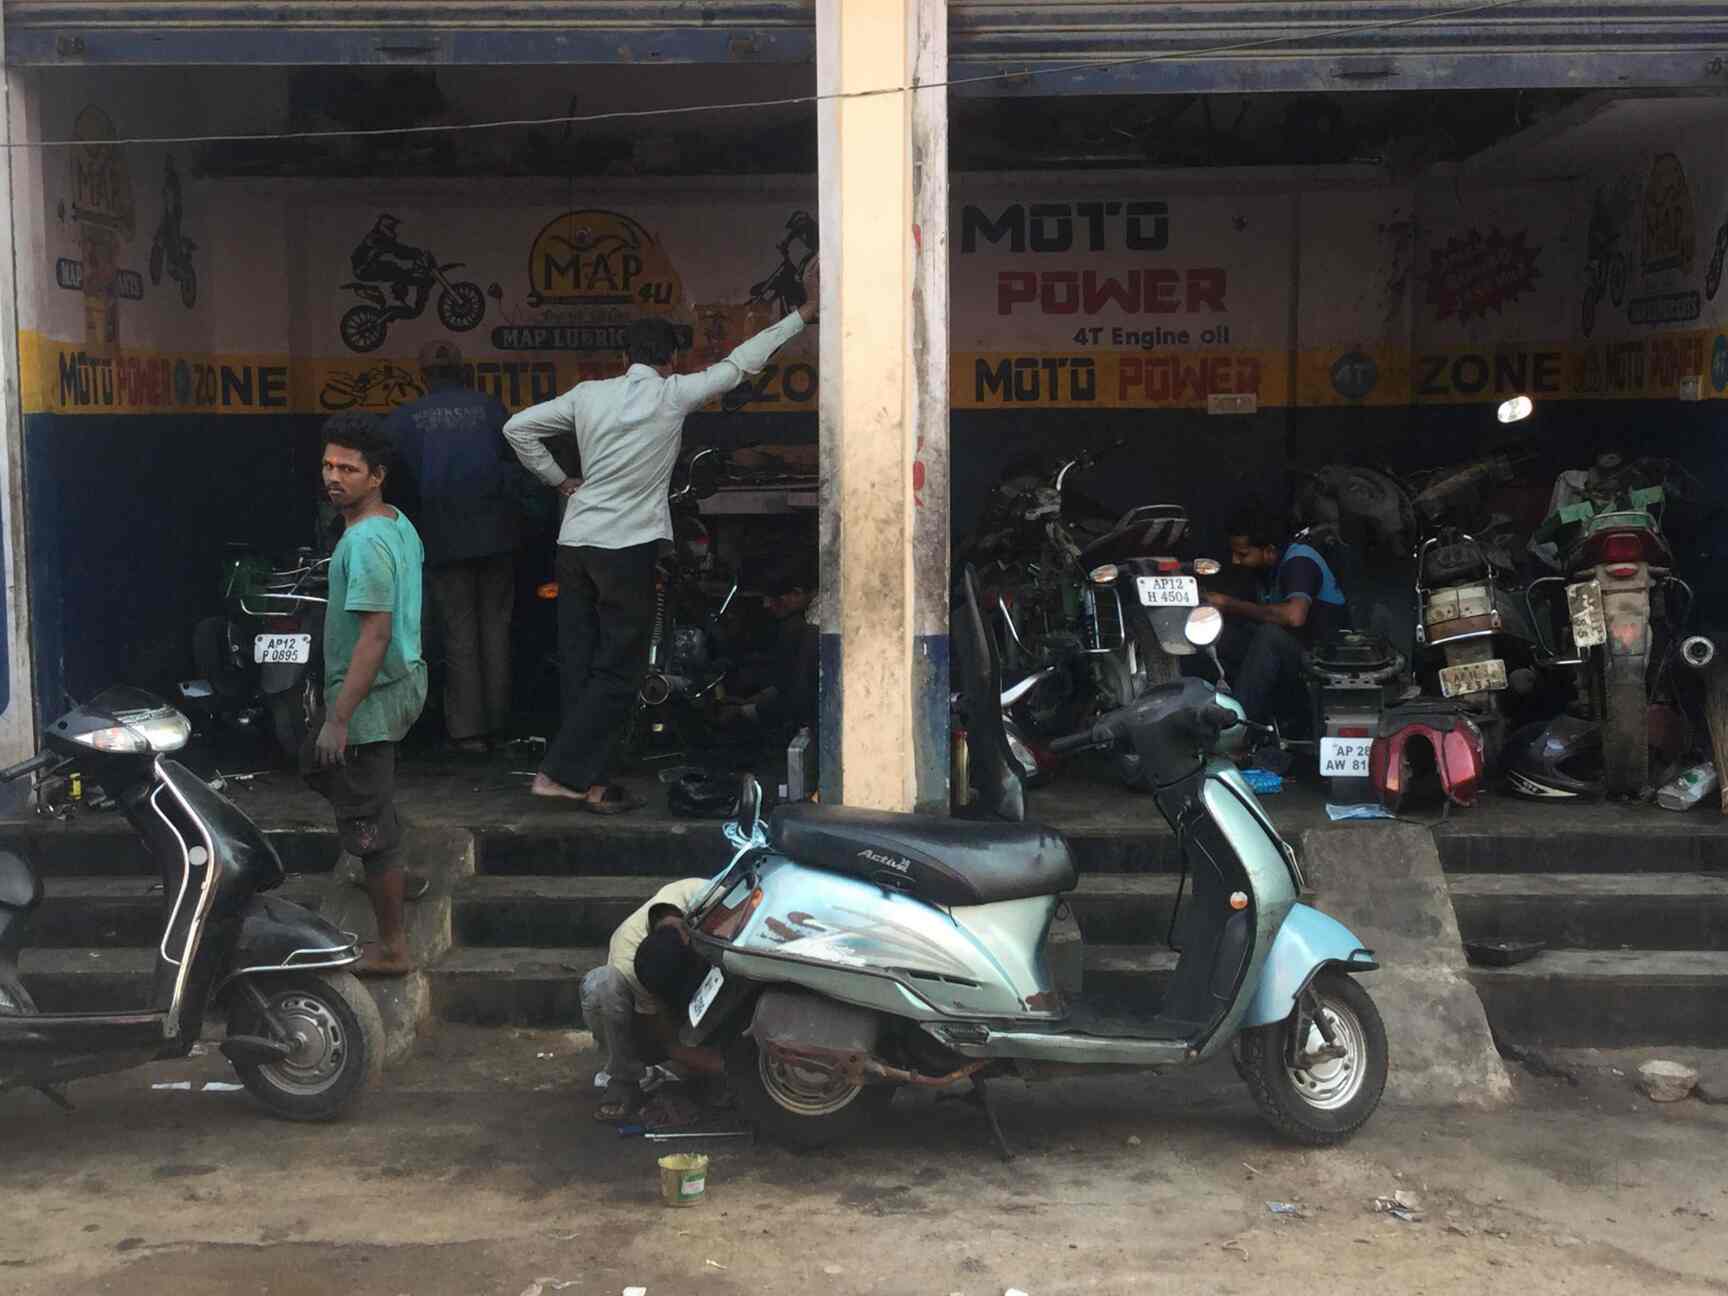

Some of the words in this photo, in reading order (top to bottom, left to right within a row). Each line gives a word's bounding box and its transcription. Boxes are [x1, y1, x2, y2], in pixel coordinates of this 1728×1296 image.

[961, 202, 1168, 254] MOTO
[544, 253, 642, 291] MAP
[997, 268, 1228, 316] POWER
[503, 329, 548, 347] MAP
[1073, 327, 1102, 346] 4T
[1112, 327, 1190, 350] Engine
[1200, 325, 1230, 345] oil
[59, 351, 113, 406] MOTO
[463, 361, 557, 405] OTO
[975, 358, 1096, 402] MOTO
[1418, 351, 1562, 394] ZONE
[1153, 578, 1184, 590] AP12
[1148, 592, 1157, 602] H
[1161, 591, 1190, 602] 4504
[268, 638, 296, 649] AP12
[263, 651, 269, 661] P
[272, 651, 298, 661] 0895
[1336, 746, 1353, 757] AP
[1326, 760, 1346, 770] AW
